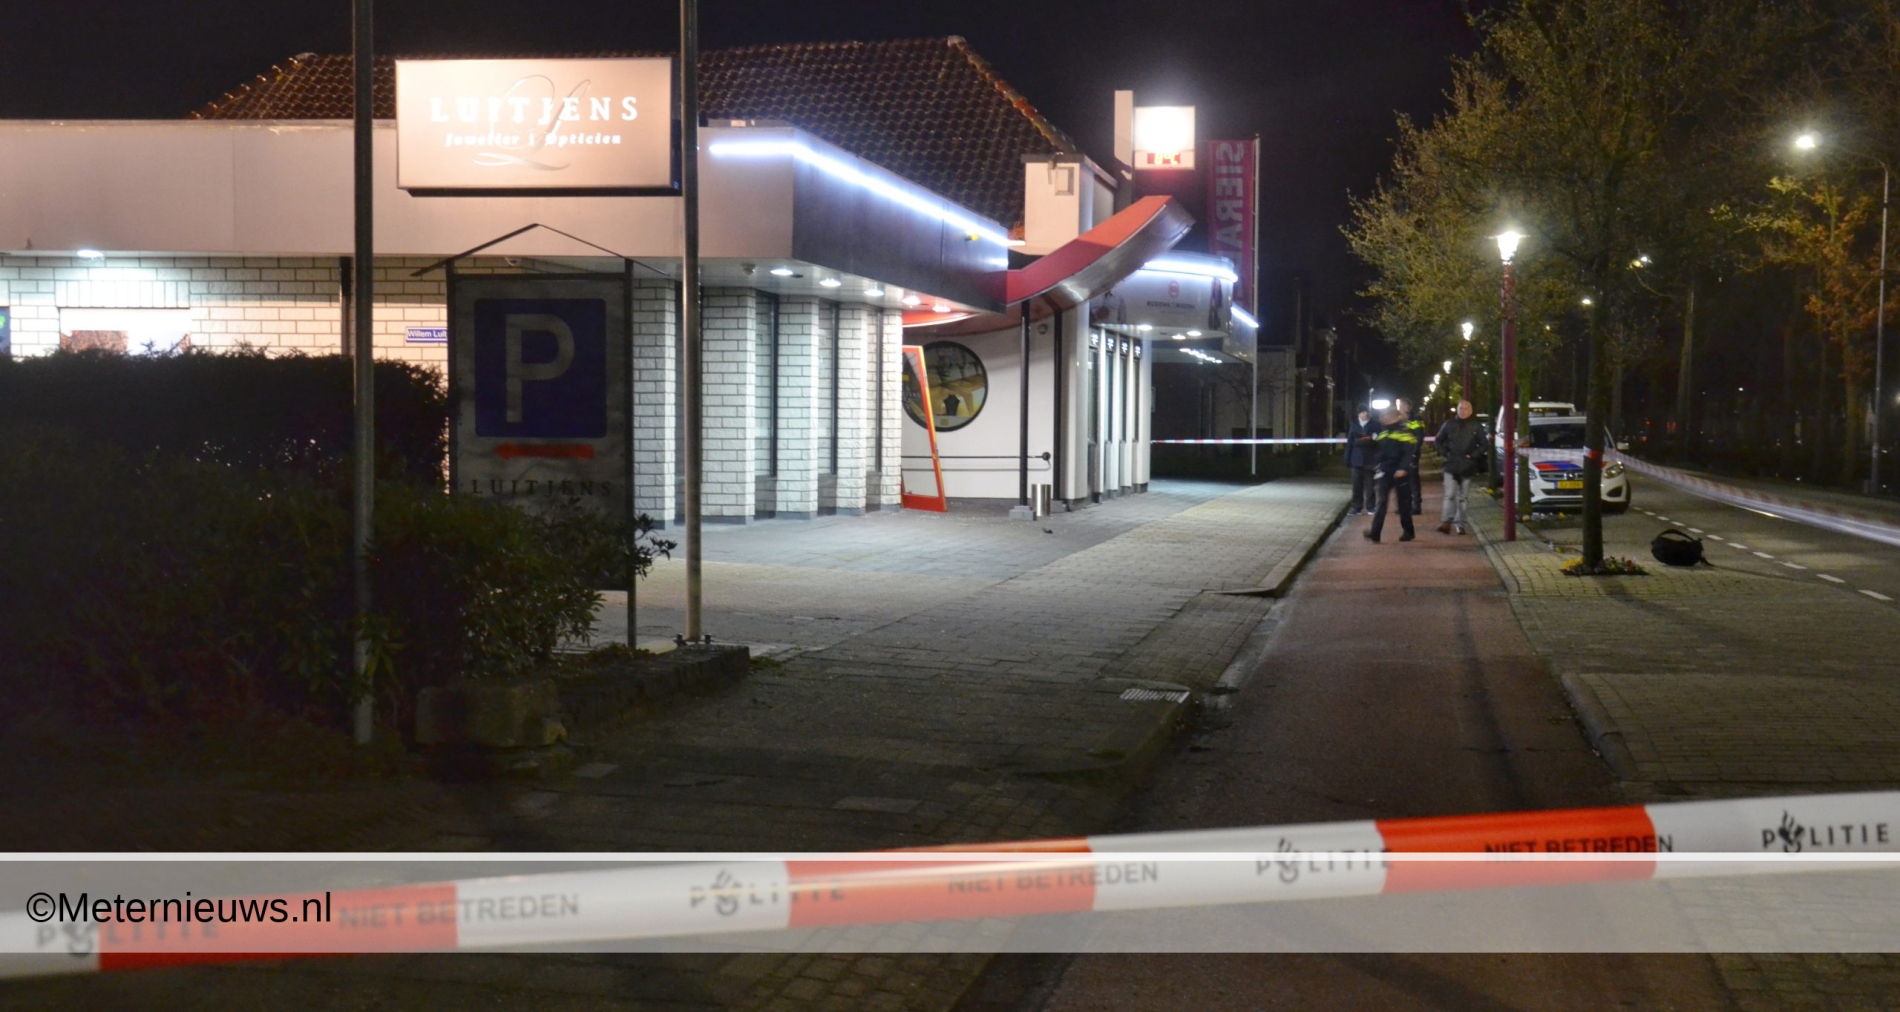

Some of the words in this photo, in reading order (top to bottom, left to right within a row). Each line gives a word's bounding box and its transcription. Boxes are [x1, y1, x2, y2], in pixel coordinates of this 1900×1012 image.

[429, 96, 638, 125] LUITJENS
[445, 132, 520, 148] Juwelier
[545, 132, 621, 148] Opticien
[408, 329, 432, 338] Willem
[506, 313, 575, 423] P
[471, 479, 611, 497] LUITJENS
[1016, 861, 1158, 891] BETREDEN
[339, 901, 405, 932] NIET
[416, 893, 580, 927] BETREDEN
